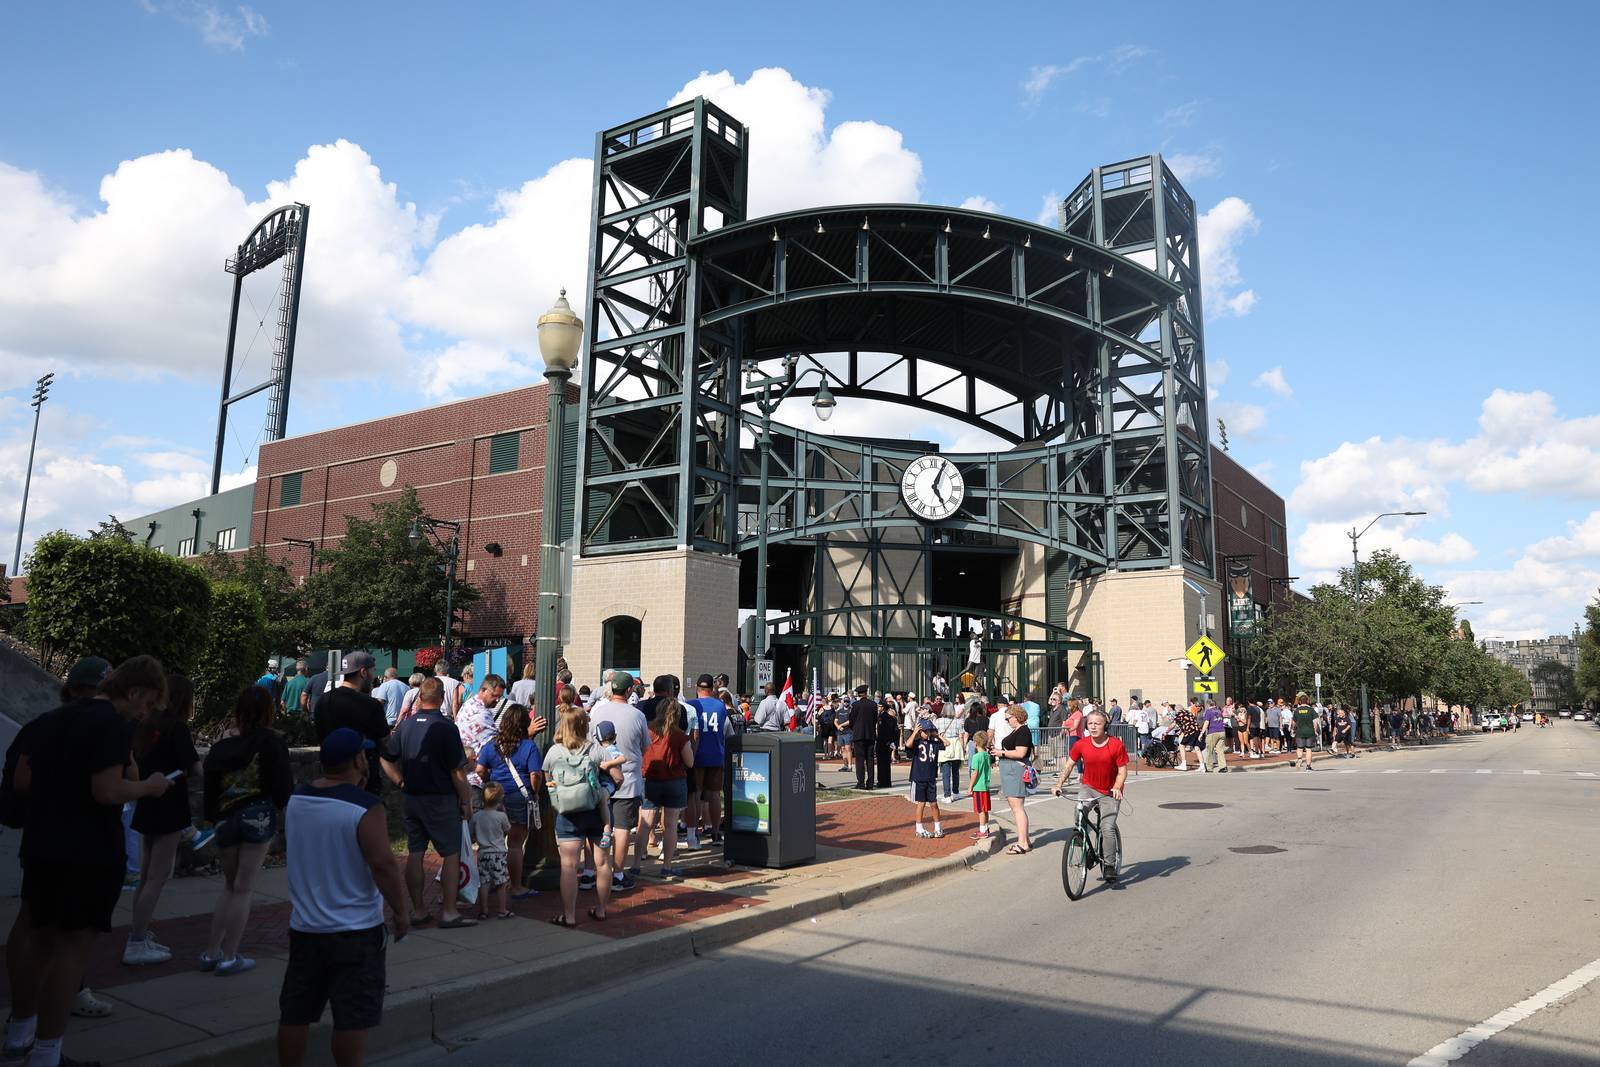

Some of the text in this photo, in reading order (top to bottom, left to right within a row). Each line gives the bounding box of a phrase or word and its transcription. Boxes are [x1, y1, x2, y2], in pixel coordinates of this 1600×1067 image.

[484, 638, 512, 646] TICKETS
[759, 662, 771, 671] ONE
[759, 673, 772, 681] WAY
[702, 711, 719, 732] 14
[918, 744, 936, 762] 34
